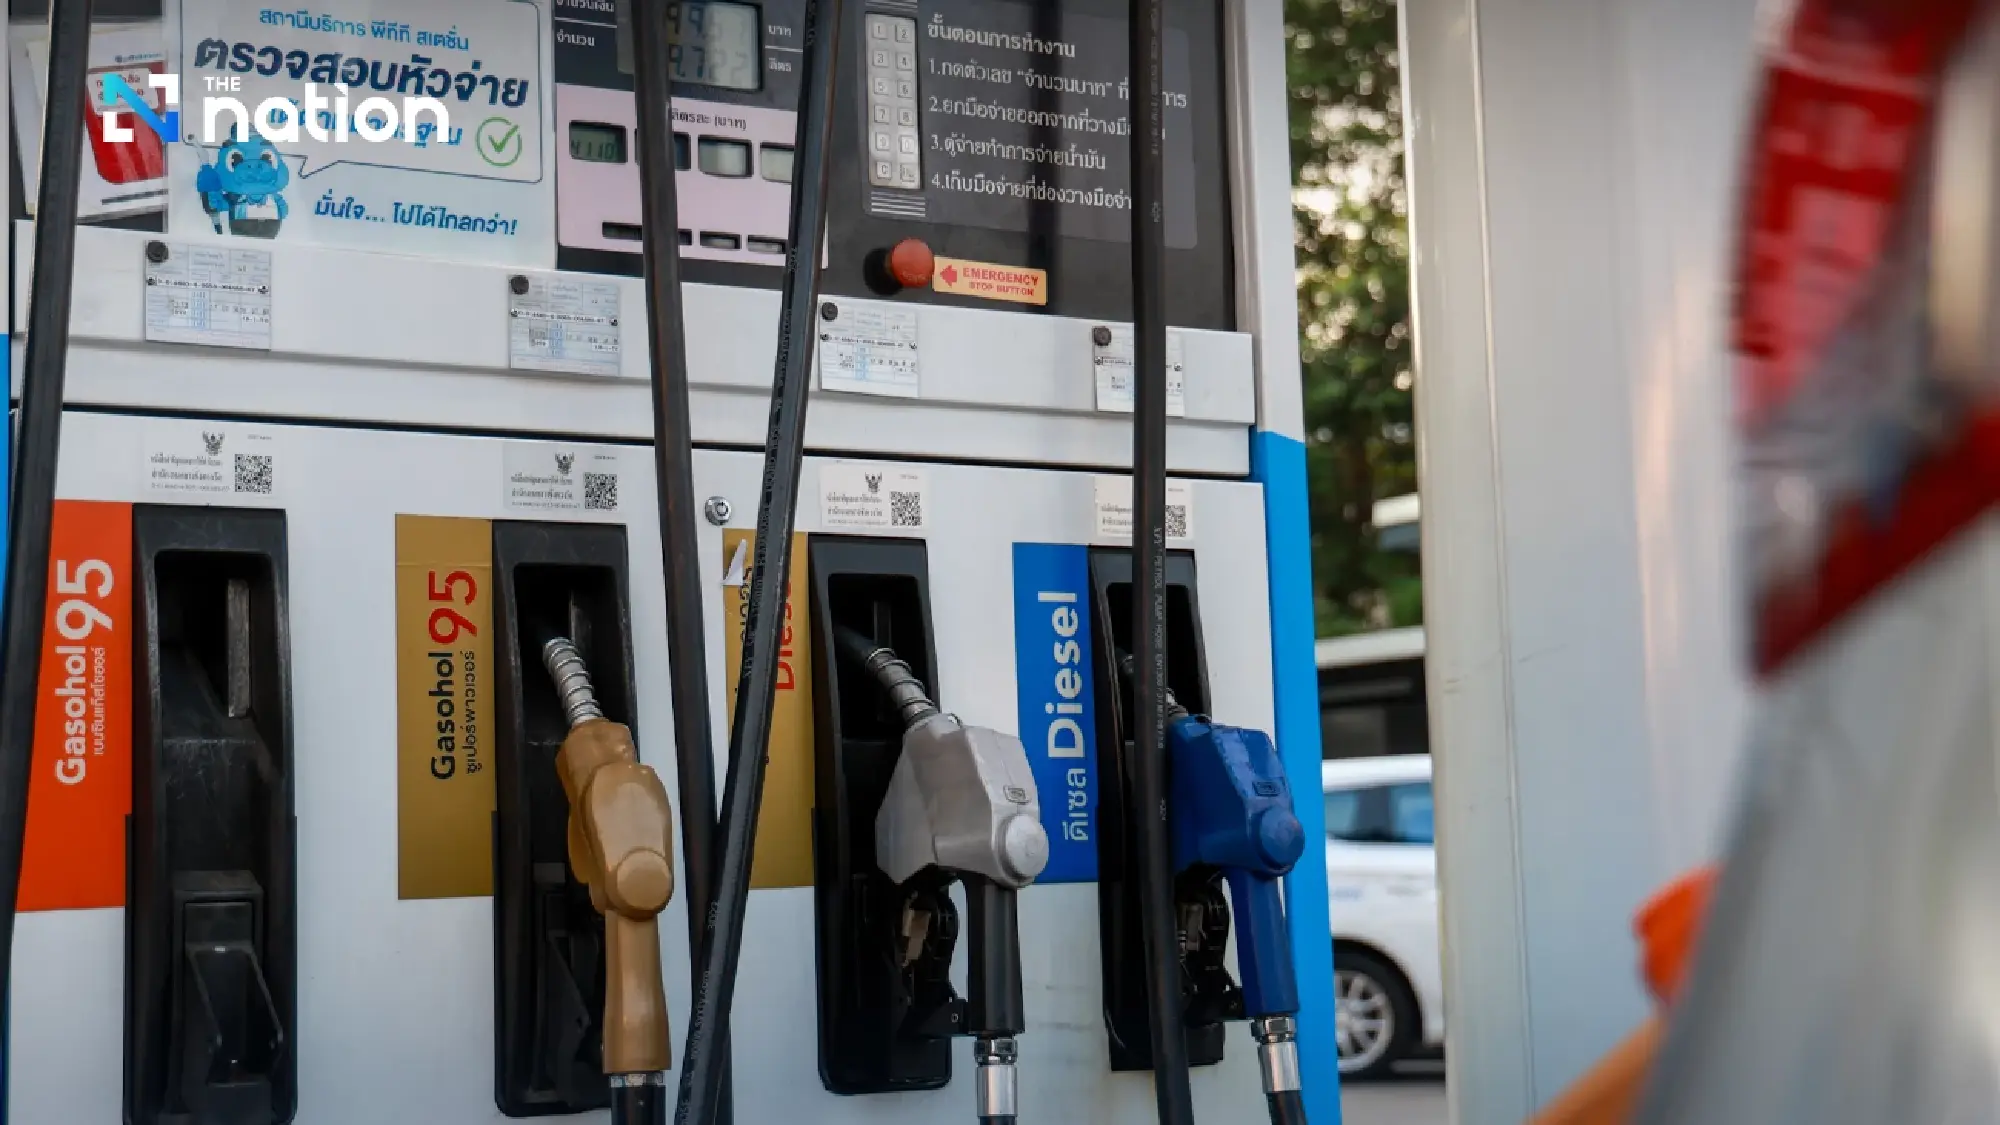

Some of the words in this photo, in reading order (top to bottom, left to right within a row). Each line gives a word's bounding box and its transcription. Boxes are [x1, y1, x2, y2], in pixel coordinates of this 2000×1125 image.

[258, 8, 366, 37] สถานีบริการ
[371, 20, 411, 43] พีทีที
[416, 24, 469, 51] สเตชั่น
[928, 13, 1076, 58] ขั้นตอนการทำงาน
[194, 37, 529, 108] ตรวจสอบหัวจ่าย
[393, 201, 518, 236] ไปได้ไกลกว่า!
[931, 168, 1132, 210] 4.เก็บมือจ่ายที่ช่องวางมือจ่า
[962, 267, 1039, 286] EMERGENCY
[968, 281, 993, 290] STOP
[996, 285, 1035, 296] BUTTON
[56, 559, 114, 640] 95
[428, 570, 478, 645] 95
[1038, 590, 1086, 758] Diesel
[55, 646, 86, 785] Gasohol
[428, 652, 456, 780] Gasohol
[460, 650, 483, 774] ซูเปอร์พาวเวอร์
[1062, 767, 1089, 842] ดีเซล
